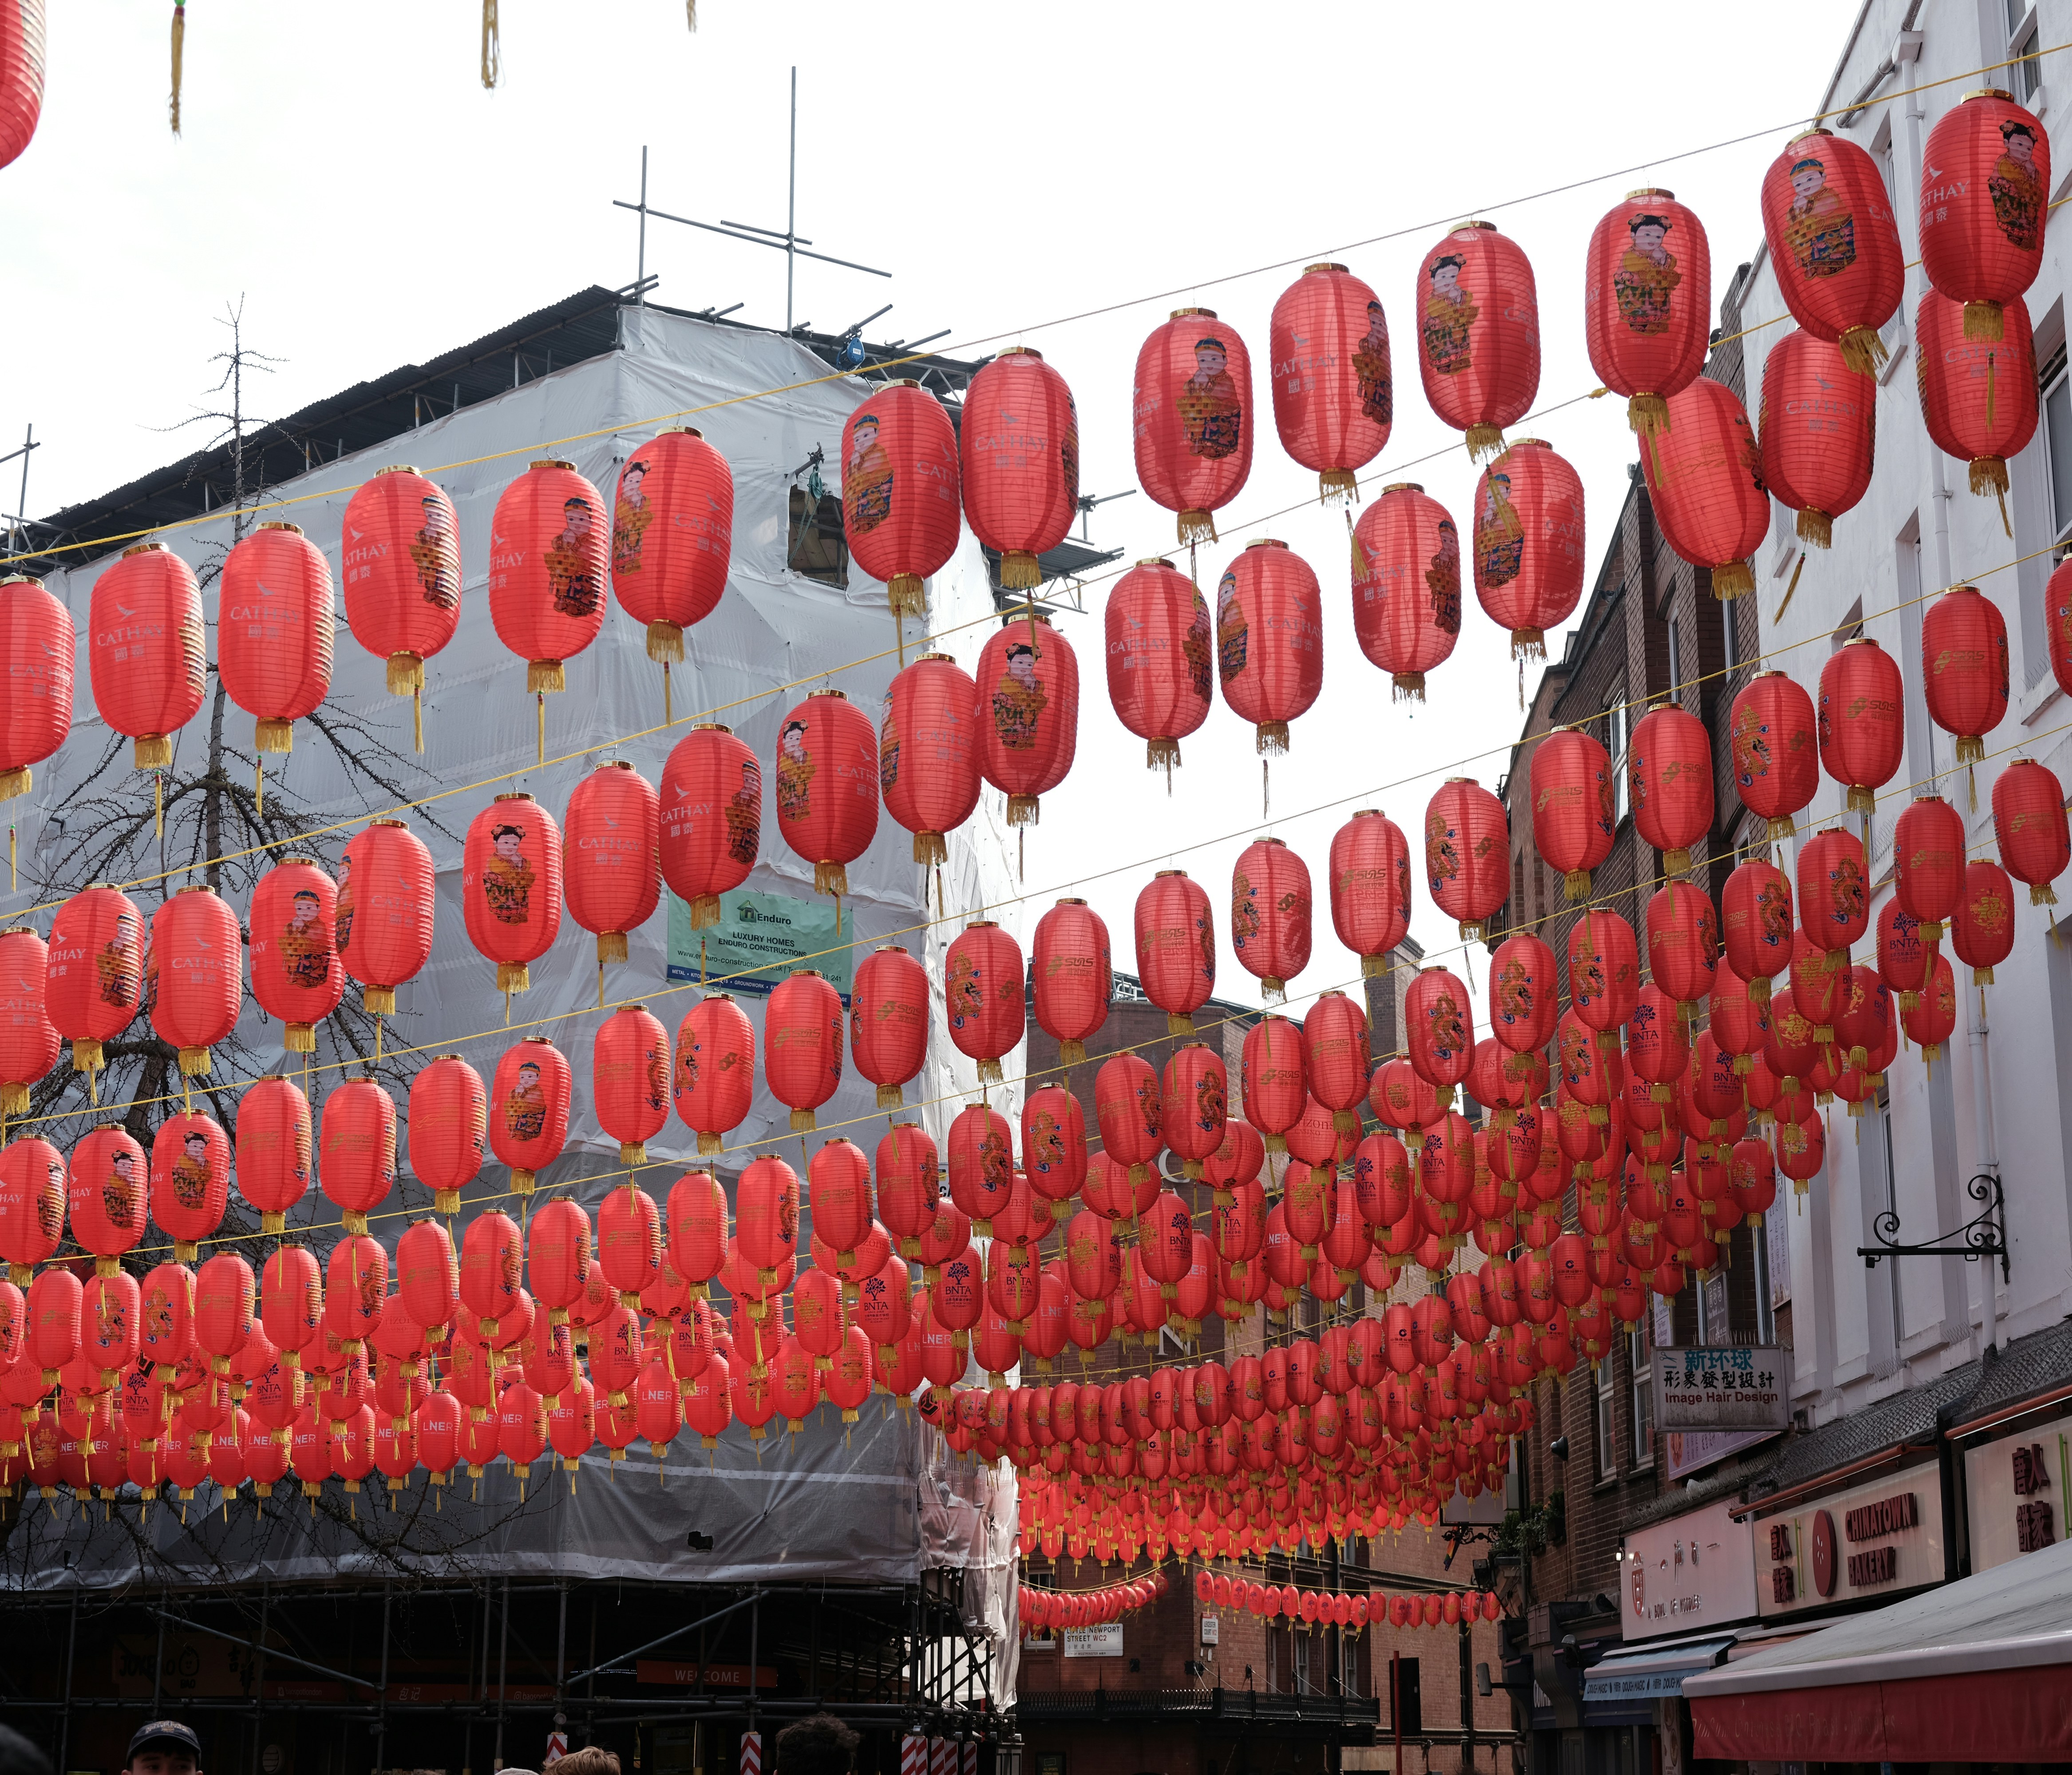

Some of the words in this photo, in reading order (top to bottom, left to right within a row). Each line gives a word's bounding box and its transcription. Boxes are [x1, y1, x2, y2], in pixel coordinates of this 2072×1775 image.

[1274, 354, 1340, 379] CATHAY
[1785, 400, 1860, 417] CATHAY
[976, 435, 1048, 451] CATHAY
[230, 606, 301, 623] CATHAY
[97, 624, 166, 647] CATHAY
[1110, 638, 1170, 655] CATHAY
[661, 803, 713, 825] CATHAY
[579, 837, 641, 852] CATHAY
[757, 913, 791, 925] Enduro
[732, 931, 764, 943] LUXURY
[767, 936, 795, 947] HOMES
[1890, 938, 1921, 950] BNTA
[718, 938, 747, 949] ENDURO
[749, 943, 807, 957] CONSTRUCTIONS
[734, 980, 764, 989] GROUNDWORK
[1632, 1030, 1658, 1043] BNTA
[1714, 1073, 1740, 1083] BNTA
[1511, 1135, 1536, 1148] BNTA
[1424, 1158, 1445, 1168] BNTA
[1170, 1236, 1192, 1246] BNTA
[945, 1286, 972, 1295] BNTA
[864, 1301, 889, 1311] BNTA
[922, 1334, 952, 1345] LNER
[1684, 1349, 1753, 1372] 新环球
[1664, 1371, 1775, 1390] 形象發型設計
[257, 1383, 281, 1393] BNTA
[642, 1389, 673, 1401] LNER
[125, 1396, 149, 1405] BNTA
[1665, 1392, 1703, 1405] Image
[1706, 1392, 1732, 1403] Hair
[1734, 1391, 1778, 1404] Design
[423, 1420, 453, 1432] LNER
[213, 1435, 241, 1446] LNER
[2012, 1443, 2050, 1495] 唐人
[1845, 1492, 1918, 1542] CHINATOWN
[2016, 1501, 2056, 1553] 餅家
[1770, 1524, 1791, 1561] 唐人
[1847, 1546, 1895, 1587] BAKERY
[1654, 1602, 1668, 1619] BOWL
[1680, 1594, 1701, 1614] NOODLES
[1587, 1684, 1597, 1693] DOUGH
[1597, 1683, 1608, 1693] MAGIC
[1622, 1681, 1633, 1692] DOUGH
[1633, 1680, 1645, 1692] MAGIC
[399, 1687, 421, 1701] 包记
